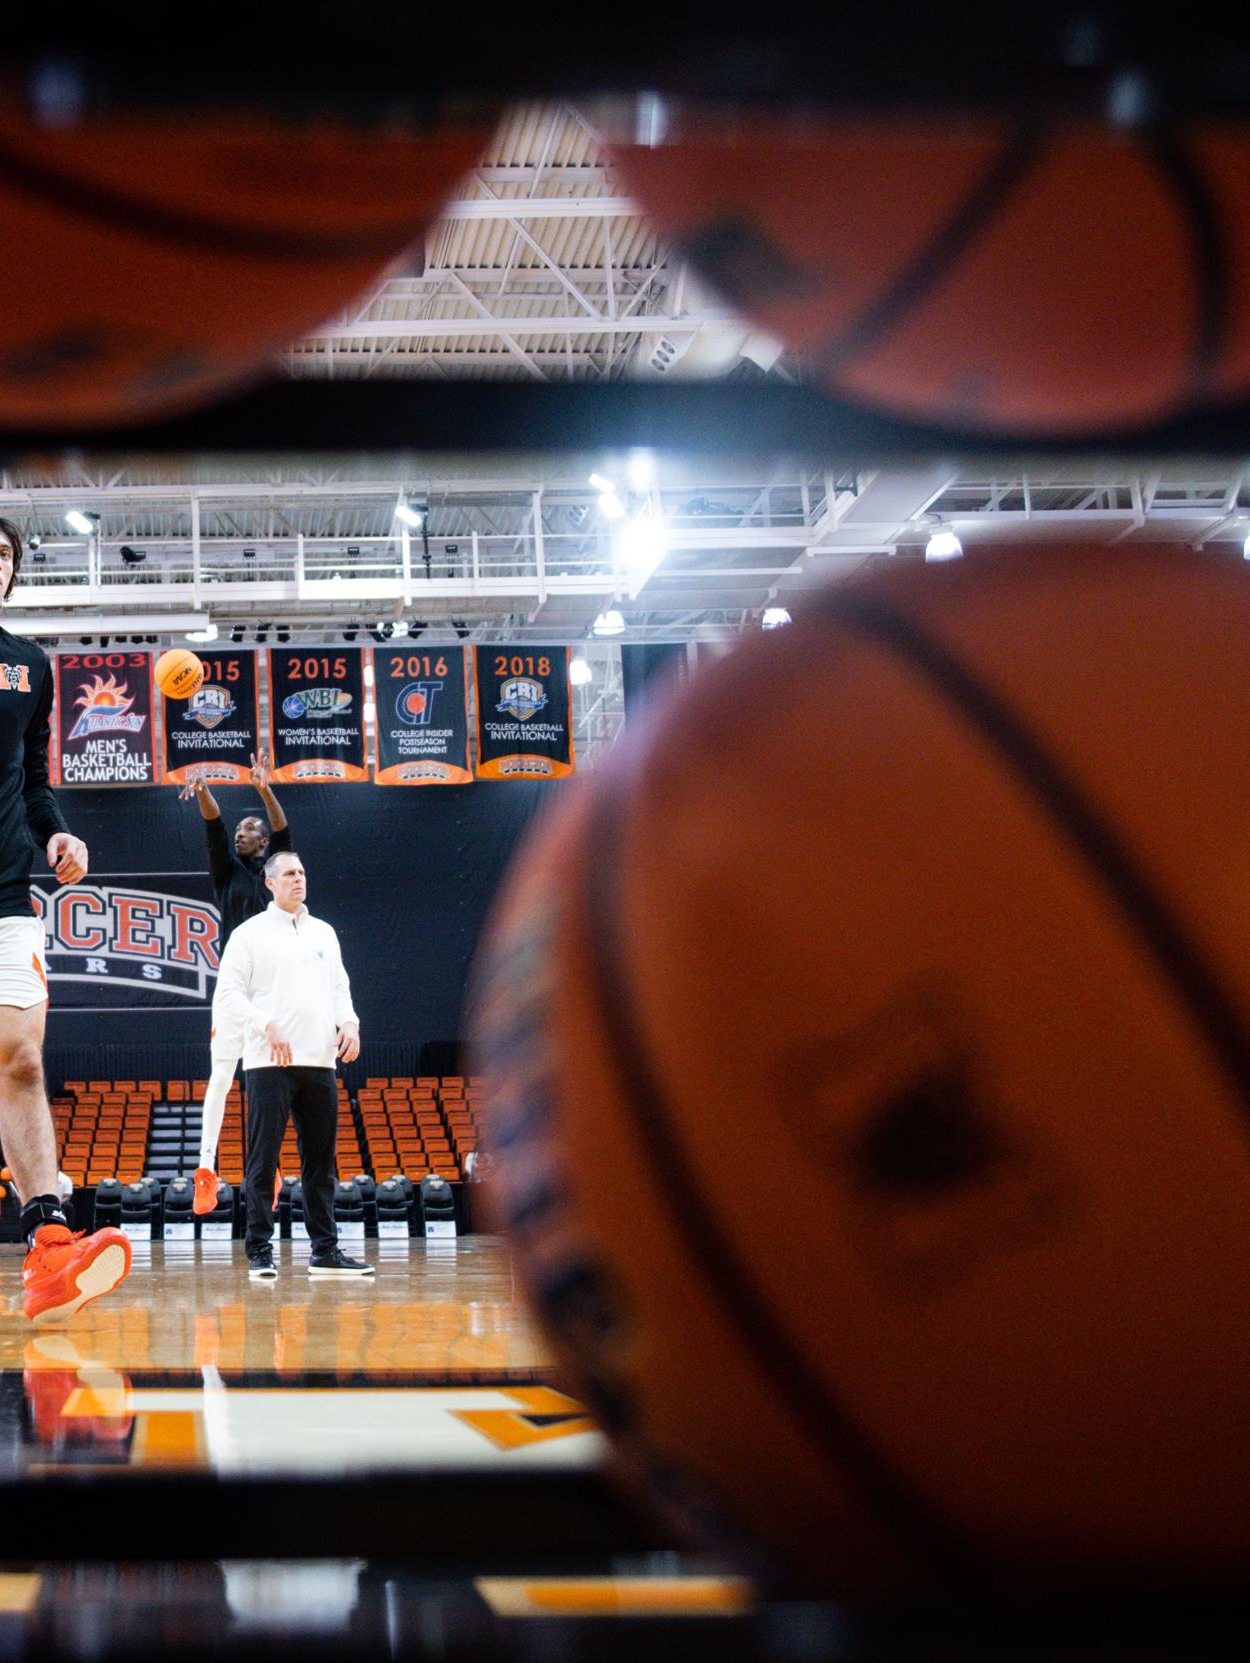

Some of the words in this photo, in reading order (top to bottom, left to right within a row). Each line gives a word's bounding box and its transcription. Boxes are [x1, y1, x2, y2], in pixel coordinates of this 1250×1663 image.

[62, 653, 146, 669] 2003
[390, 656, 449, 678] 2016
[494, 655, 551, 677] 2018
[202, 661, 240, 682] 015
[287, 658, 347, 680] 2015
[300, 688, 342, 709] WBI
[505, 681, 538, 701] CBI
[194, 689, 225, 709] CBI
[278, 728, 316, 736] WOMEN'S
[317, 727, 359, 736] BASKETBALL
[390, 729, 425, 738] COLLEGE
[426, 728, 454, 737] INSIDER
[484, 722, 520, 732] COLLEGE
[521, 723, 564, 732] BASKETBALL
[171, 731, 207, 740] COLLEGE
[208, 730, 251, 739] BASKETBALL
[285, 735, 352, 746] INVITATIONAL
[399, 737, 446, 746] POSTSEASON
[491, 730, 557, 741] INVITATIONAL
[85, 739, 127, 754] MEN'S
[177, 738, 245, 749] INVITATIONAL
[398, 746, 448, 755] TOURNAMENT
[62, 752, 152, 768] BASKETBALL
[64, 766, 149, 782] CHAMPIONS
